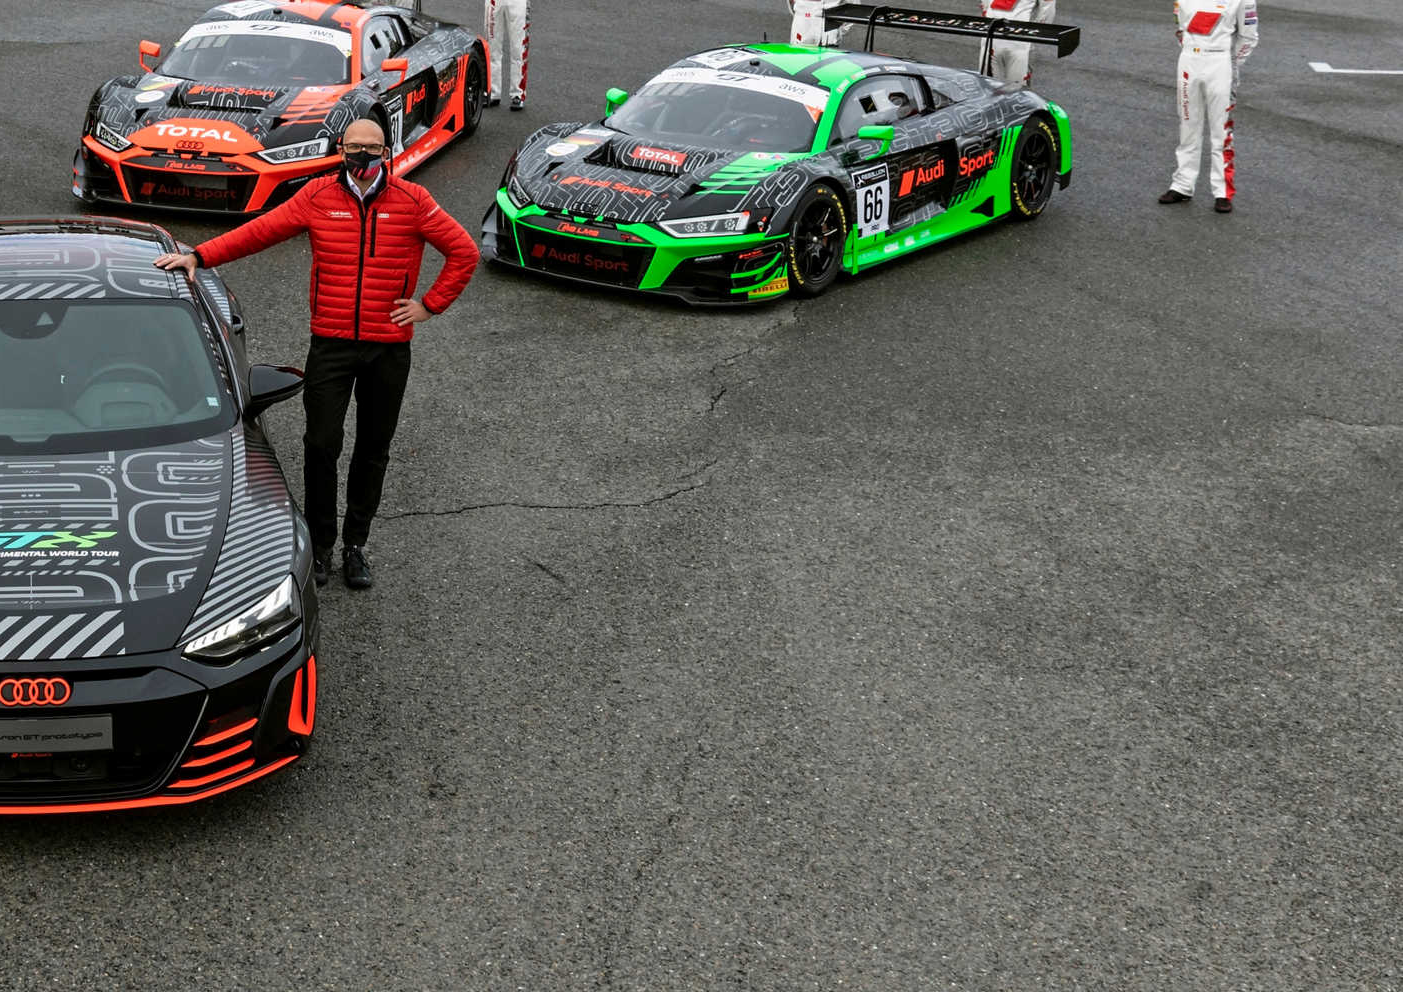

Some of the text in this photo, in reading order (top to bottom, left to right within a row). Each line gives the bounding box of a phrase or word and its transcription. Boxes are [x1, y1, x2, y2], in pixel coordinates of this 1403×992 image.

[205, 86, 235, 94] Audi
[413, 83, 425, 106] Audi
[438, 77, 455, 98] Sport
[155, 123, 238, 143] TOTAL
[638, 147, 680, 163] TOTAL
[916, 148, 995, 186] Audi Sport
[157, 184, 237, 200] Audi Sport
[578, 178, 653, 198] Audi Sport
[863, 186, 883, 224] 66
[548, 248, 630, 272] Audi Sport
[49, 550, 89, 558] WORLD
[91, 550, 119, 558] TOUR
[41, 732, 104, 741] prototype
